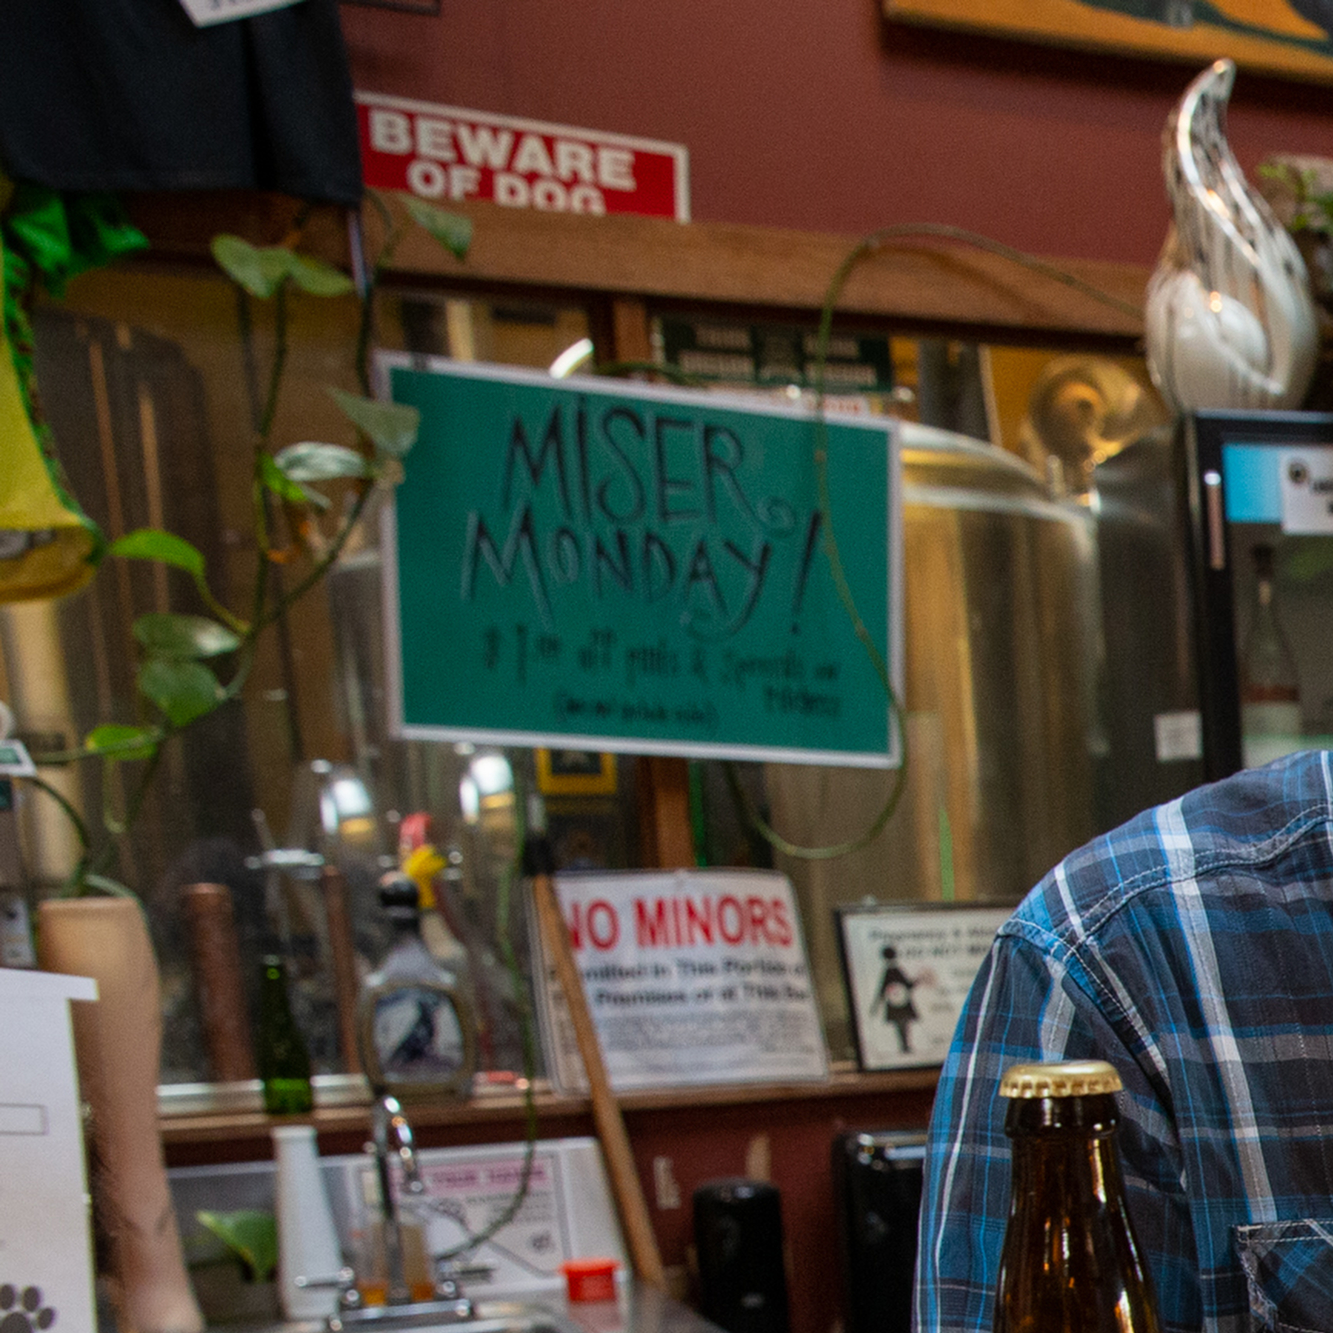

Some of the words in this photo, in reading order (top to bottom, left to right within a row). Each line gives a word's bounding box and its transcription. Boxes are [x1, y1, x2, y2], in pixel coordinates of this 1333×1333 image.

[370, 108, 637, 192] BEWARE
[406, 160, 481, 201] OF
[505, 396, 796, 537] MISER
[632, 895, 793, 949] MINORS
